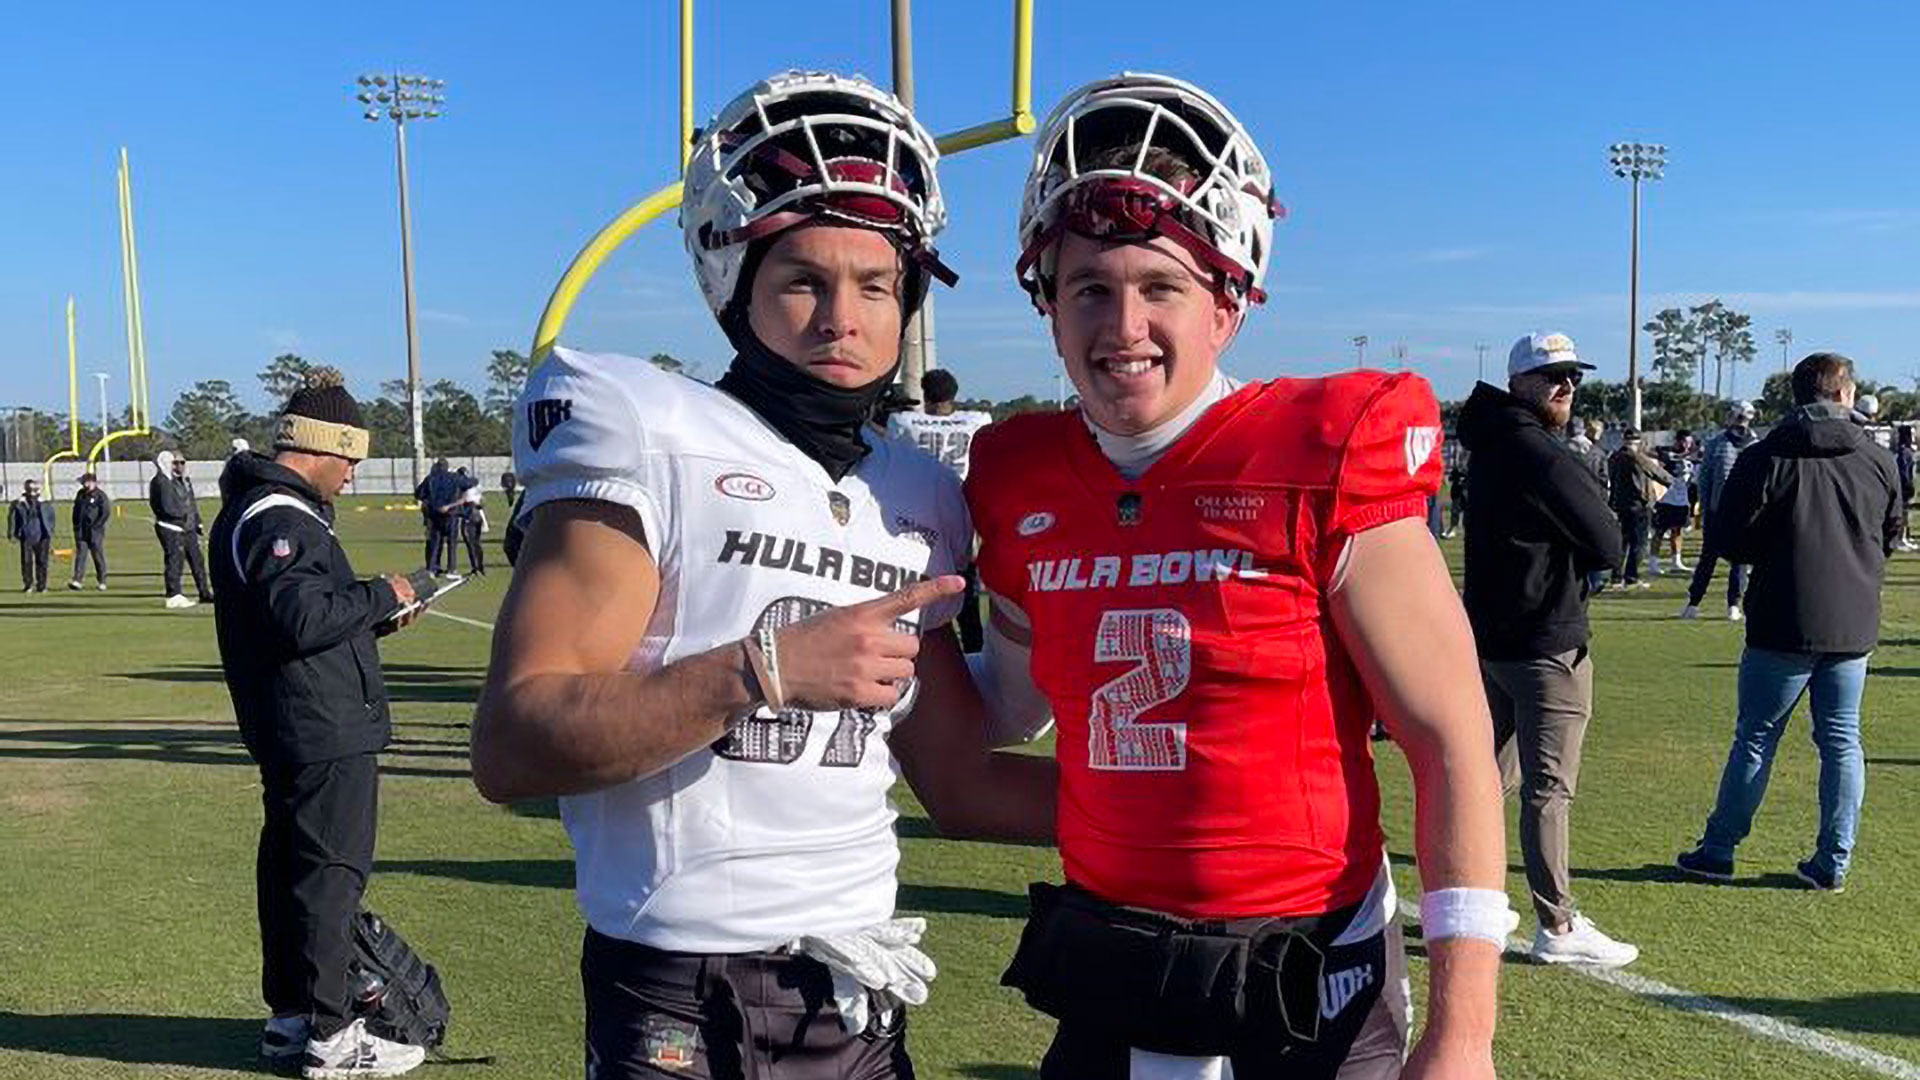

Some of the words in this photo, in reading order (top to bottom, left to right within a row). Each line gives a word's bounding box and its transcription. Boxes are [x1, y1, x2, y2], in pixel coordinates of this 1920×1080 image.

[717, 530, 844, 584] HULA
[850, 556, 932, 593] BOW
[1027, 558, 1121, 592] HULA
[1129, 549, 1268, 587] BOWL
[1088, 607, 1192, 771] 2
